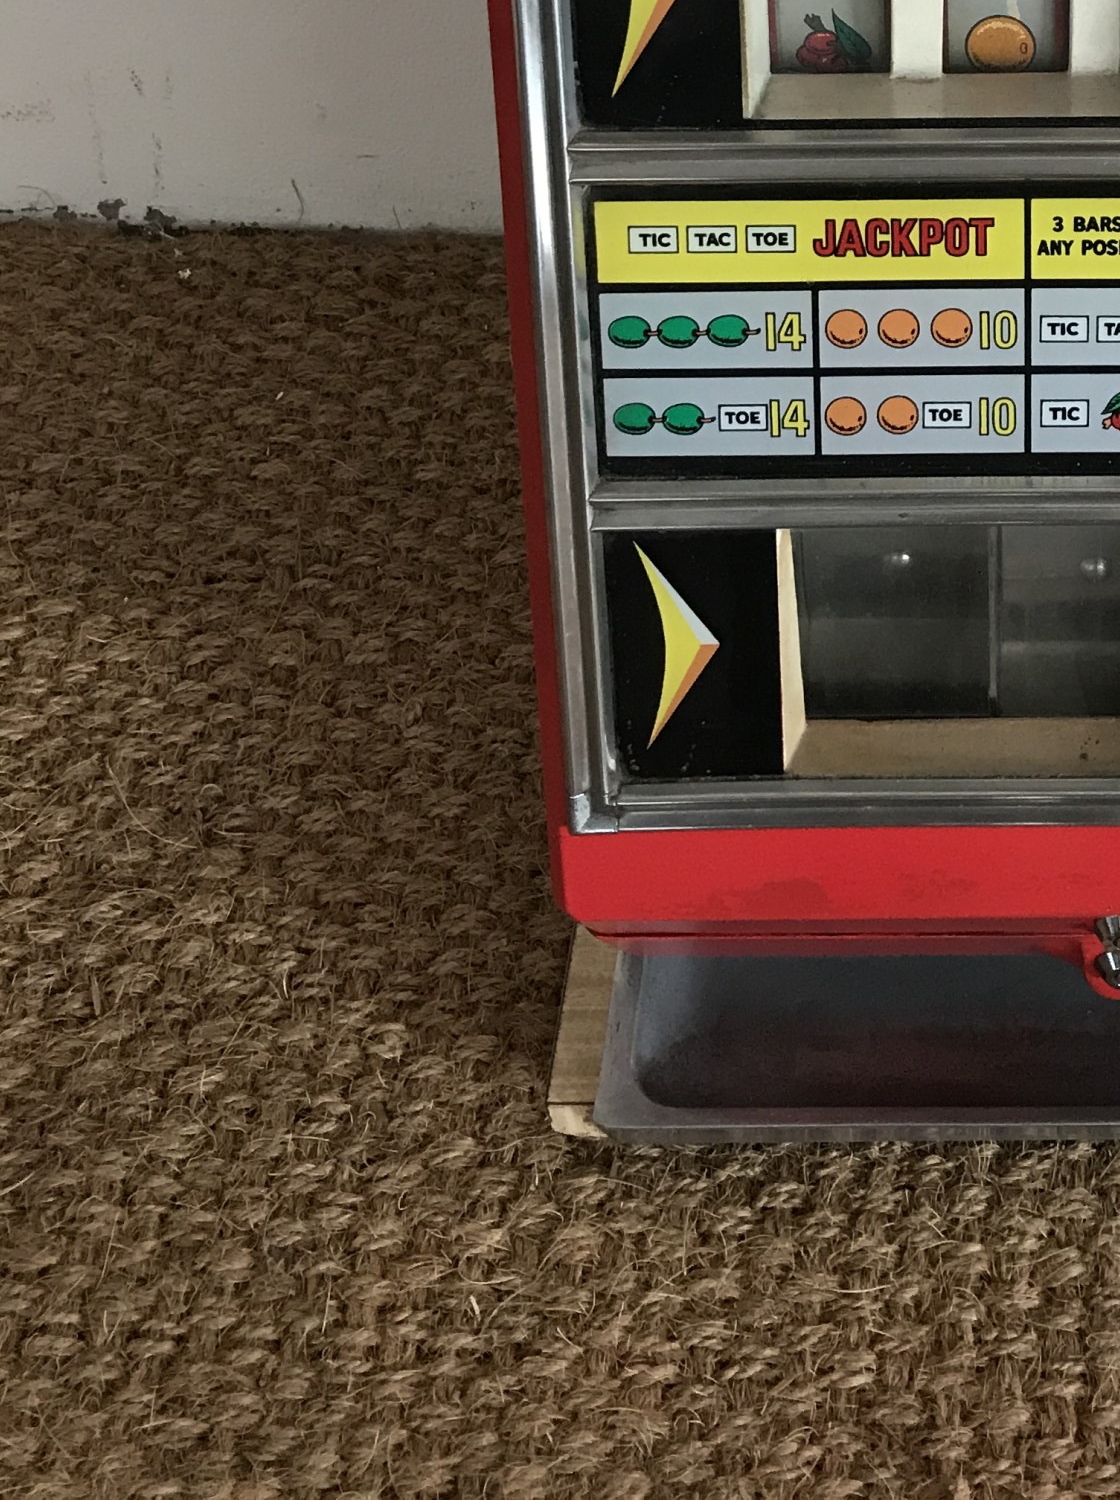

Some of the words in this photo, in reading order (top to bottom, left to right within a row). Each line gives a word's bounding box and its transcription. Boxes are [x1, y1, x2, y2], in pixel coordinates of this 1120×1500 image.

[639, 233, 671, 247] TIC
[694, 232, 731, 247] TAC
[752, 232, 789, 246] TOE
[813, 217, 995, 257] JACKPOT
[1052, 216, 1064, 232] 3
[1037, 240, 1074, 256] ANY
[765, 311, 806, 351] 14
[979, 311, 1017, 350] 10
[1047, 322, 1079, 336] TIC
[725, 411, 761, 425] TOE
[769, 398, 810, 437] 14
[929, 408, 963, 422] TOE
[979, 397, 1016, 436] 10
[1049, 406, 1080, 421] TIC
